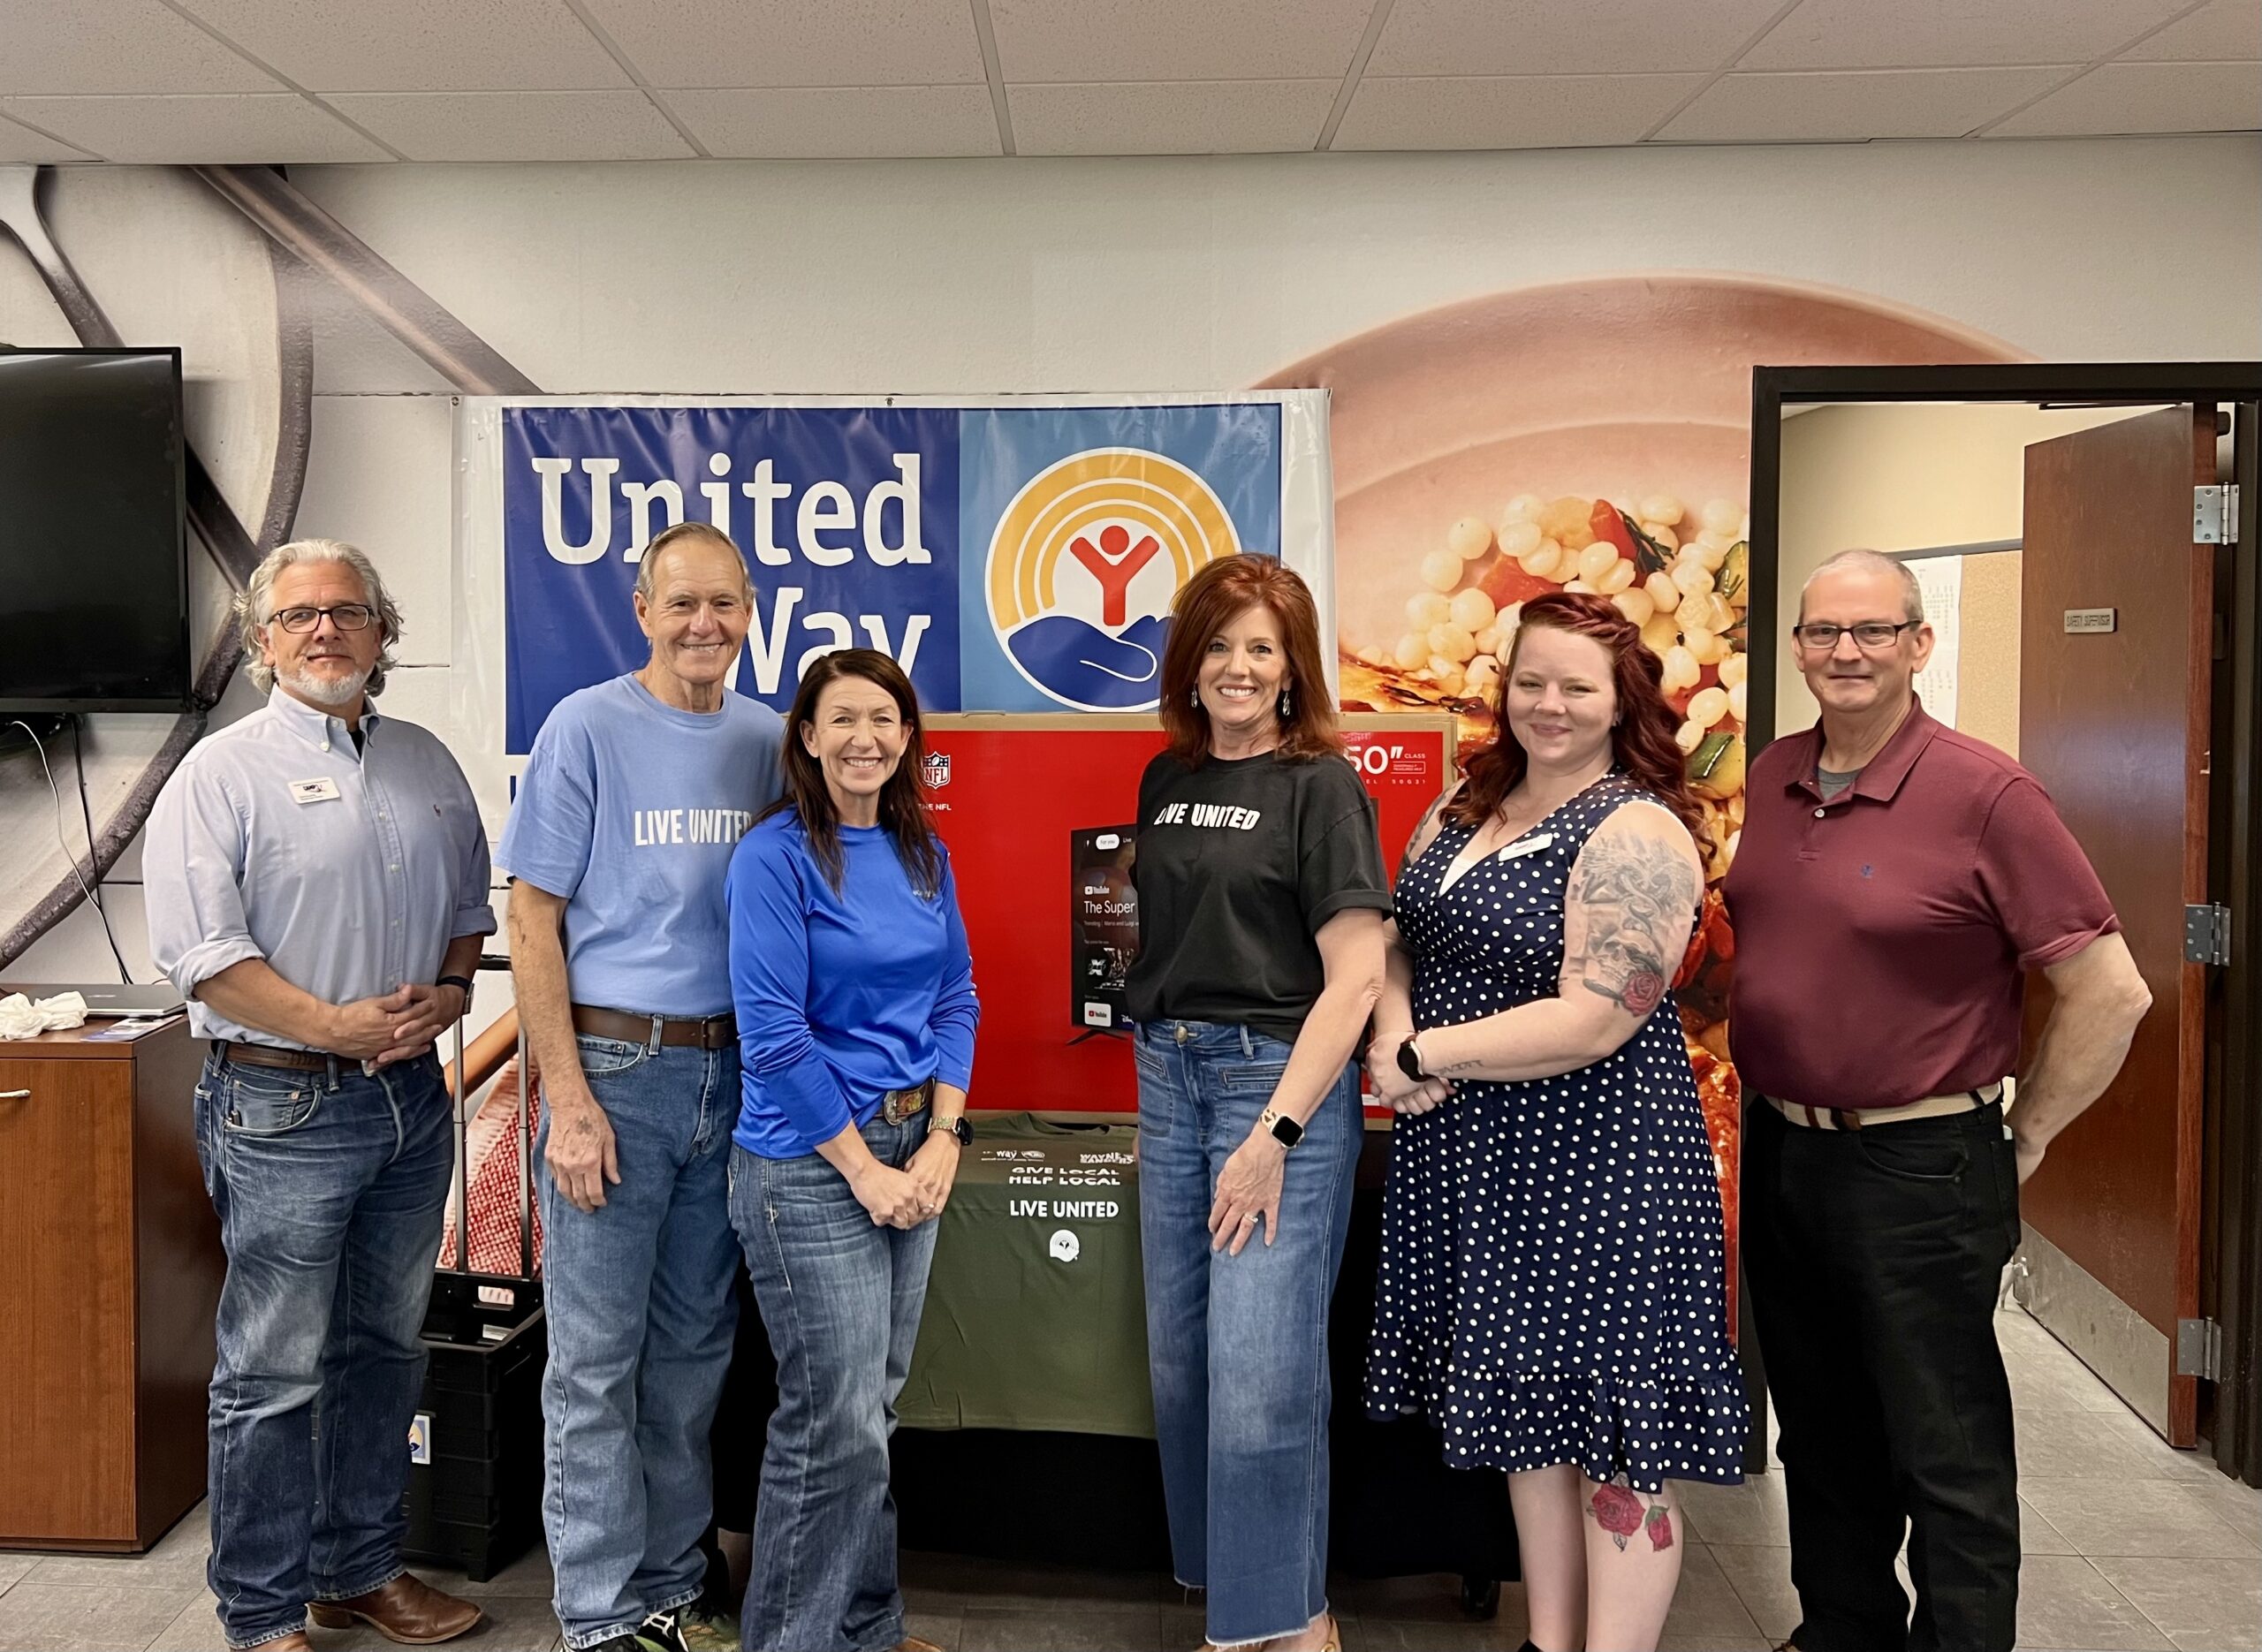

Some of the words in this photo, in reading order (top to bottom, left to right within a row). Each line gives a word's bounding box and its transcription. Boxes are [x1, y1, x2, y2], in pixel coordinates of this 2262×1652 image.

[532, 452, 931, 566] United
[924, 768, 947, 784] NFL
[1153, 802, 1189, 826] LIVE
[1190, 803, 1261, 830] UNITED
[634, 808, 684, 846] LIVE
[688, 808, 752, 845] UNITED
[1083, 900, 1103, 914] The
[1104, 899, 1135, 917] Super
[1012, 1166, 1053, 1175] GIVE
[1059, 1167, 1120, 1176] LOCAL
[1009, 1176, 1054, 1186] HELP
[1059, 1177, 1121, 1186] LOCAL
[1010, 1200, 1048, 1217] LIVE
[1052, 1201, 1120, 1218] UNITED
